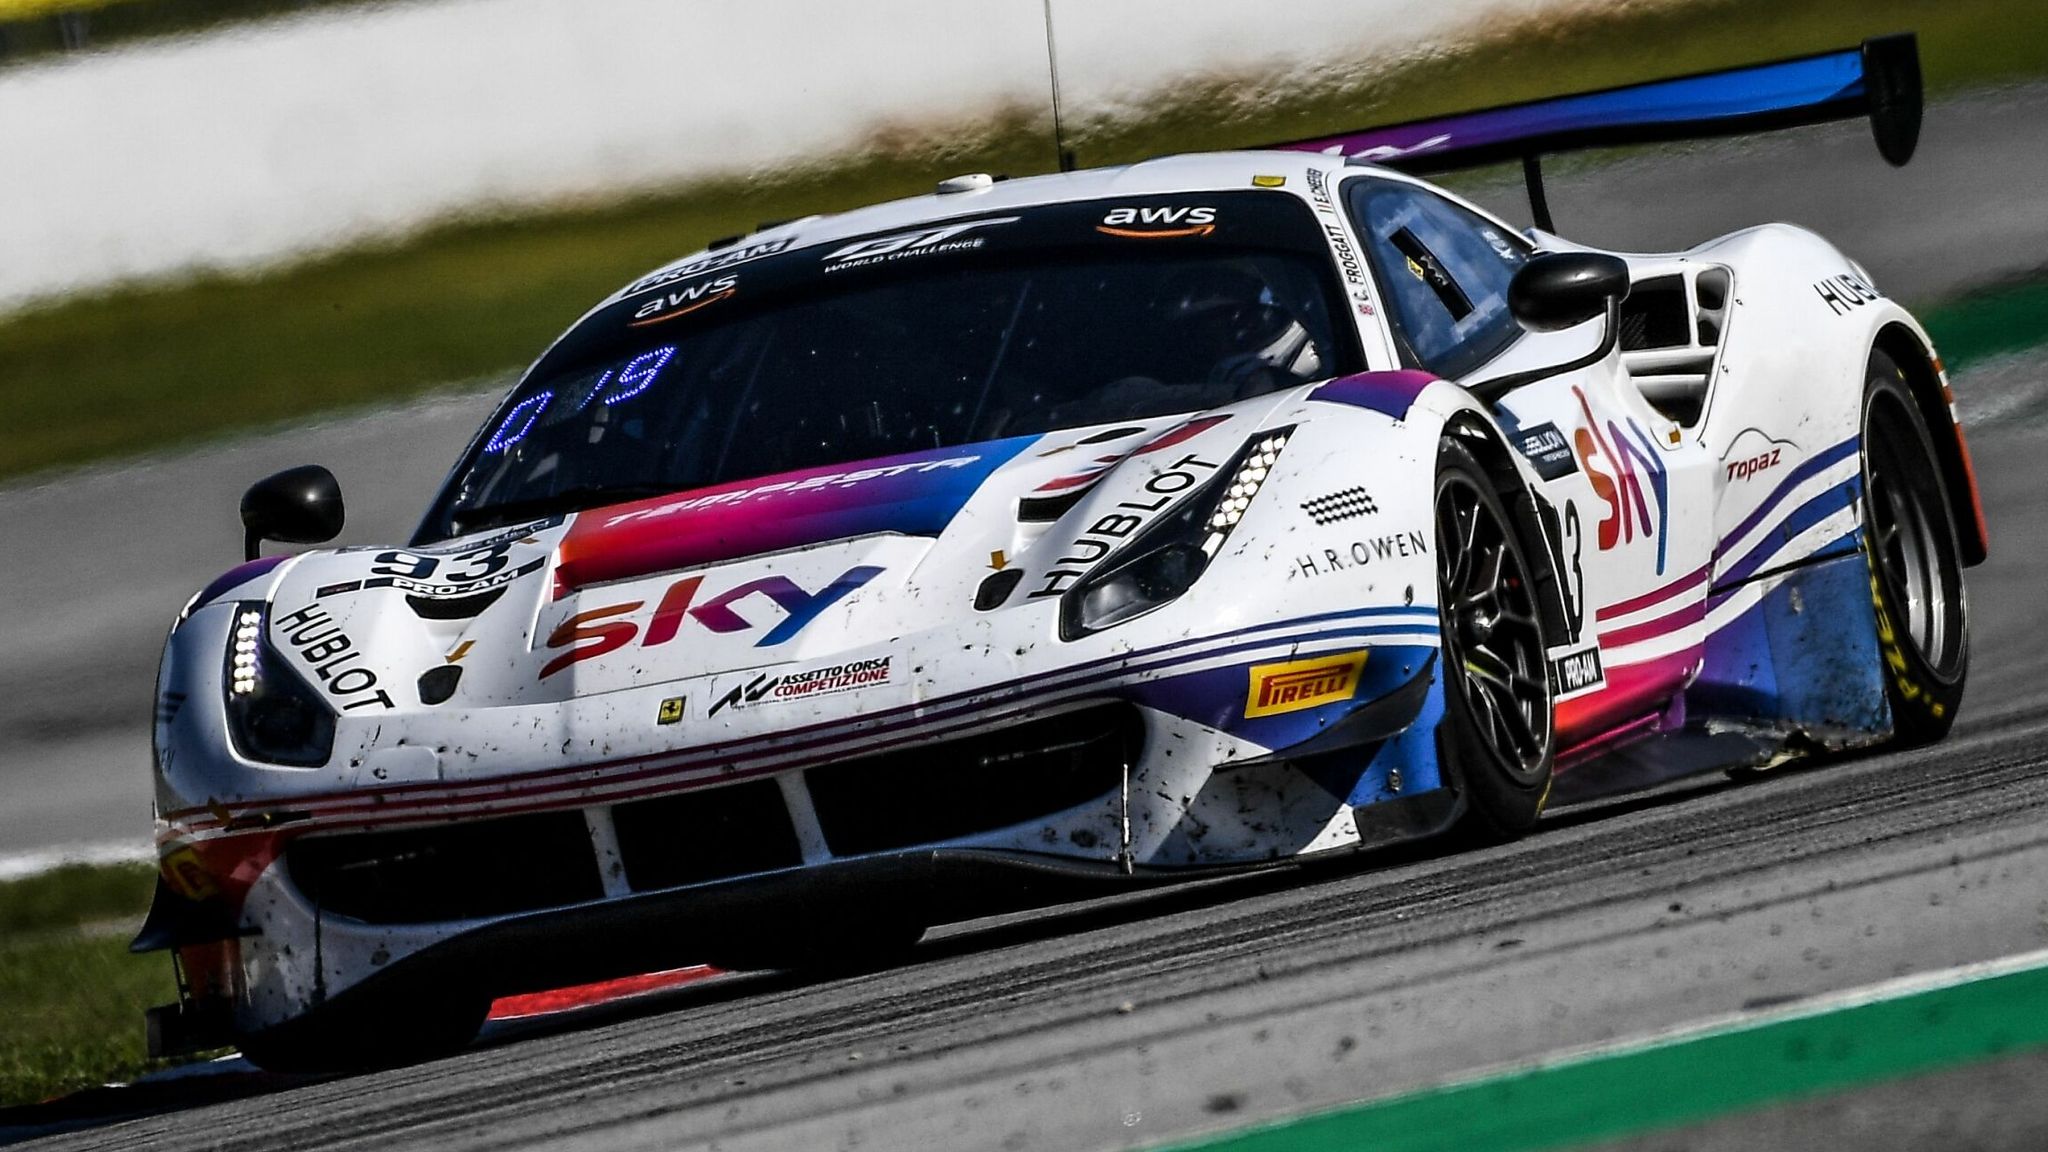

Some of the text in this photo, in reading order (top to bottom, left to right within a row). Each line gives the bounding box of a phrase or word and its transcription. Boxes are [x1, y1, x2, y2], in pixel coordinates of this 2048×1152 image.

[1103, 206, 1218, 226] aws
[632, 237, 794, 292] PRO-AM
[824, 237, 985, 274] WORLD CHALLENGE
[1325, 223, 1365, 286] FROGGATT
[634, 274, 738, 319] aws
[1572, 384, 1668, 577] sky
[1726, 448, 1781, 483] Topaz
[1028, 454, 1219, 599] HUBLOT
[370, 542, 511, 583] 93
[392, 568, 519, 600] PRO-AM
[538, 564, 887, 680] sky
[275, 603, 395, 712] HUBLOT
[782, 656, 889, 685] ASSETTO CORSA
[774, 668, 890, 698] COMPETIZIONE
[1260, 663, 1354, 707] PIRELLI
